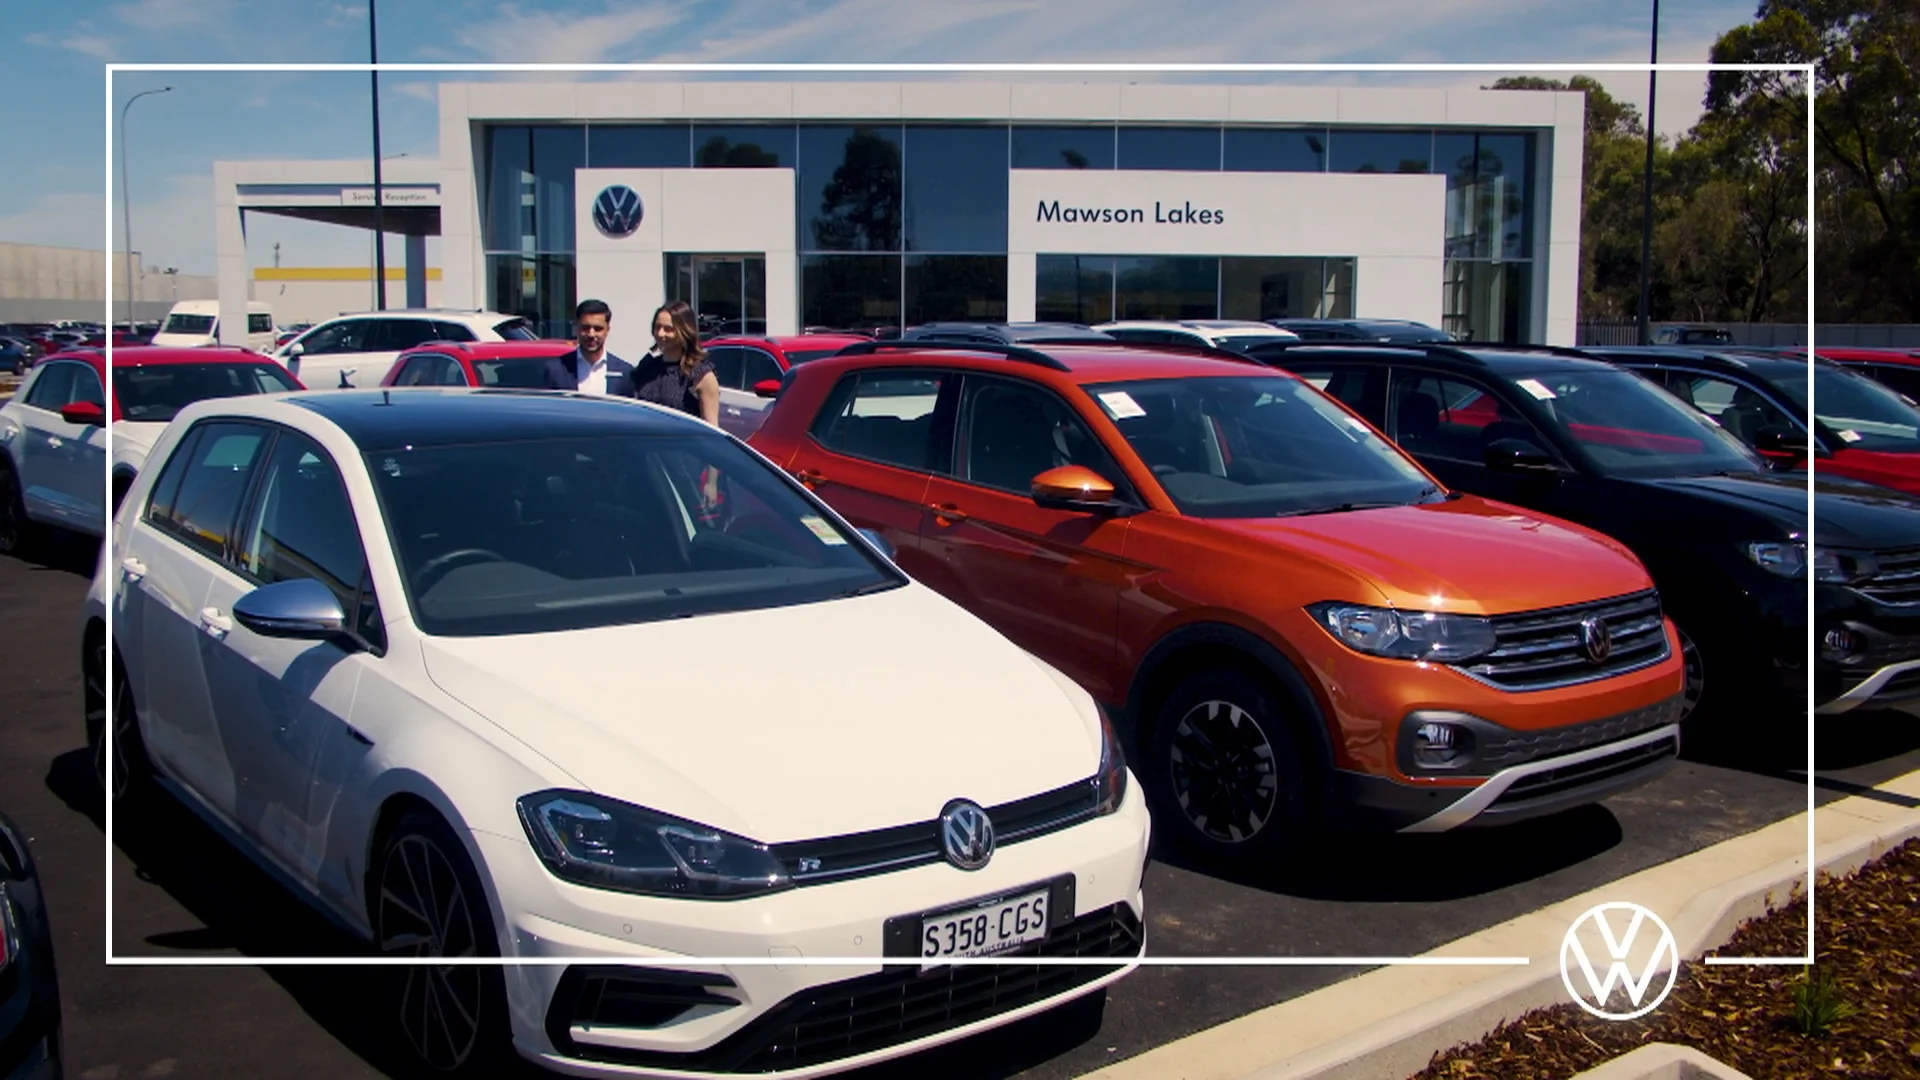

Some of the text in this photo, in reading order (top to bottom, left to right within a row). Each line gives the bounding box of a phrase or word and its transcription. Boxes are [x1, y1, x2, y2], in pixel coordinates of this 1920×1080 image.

[352, 192, 378, 202] Servi
[1036, 199, 1225, 225] Mawson Lakes
